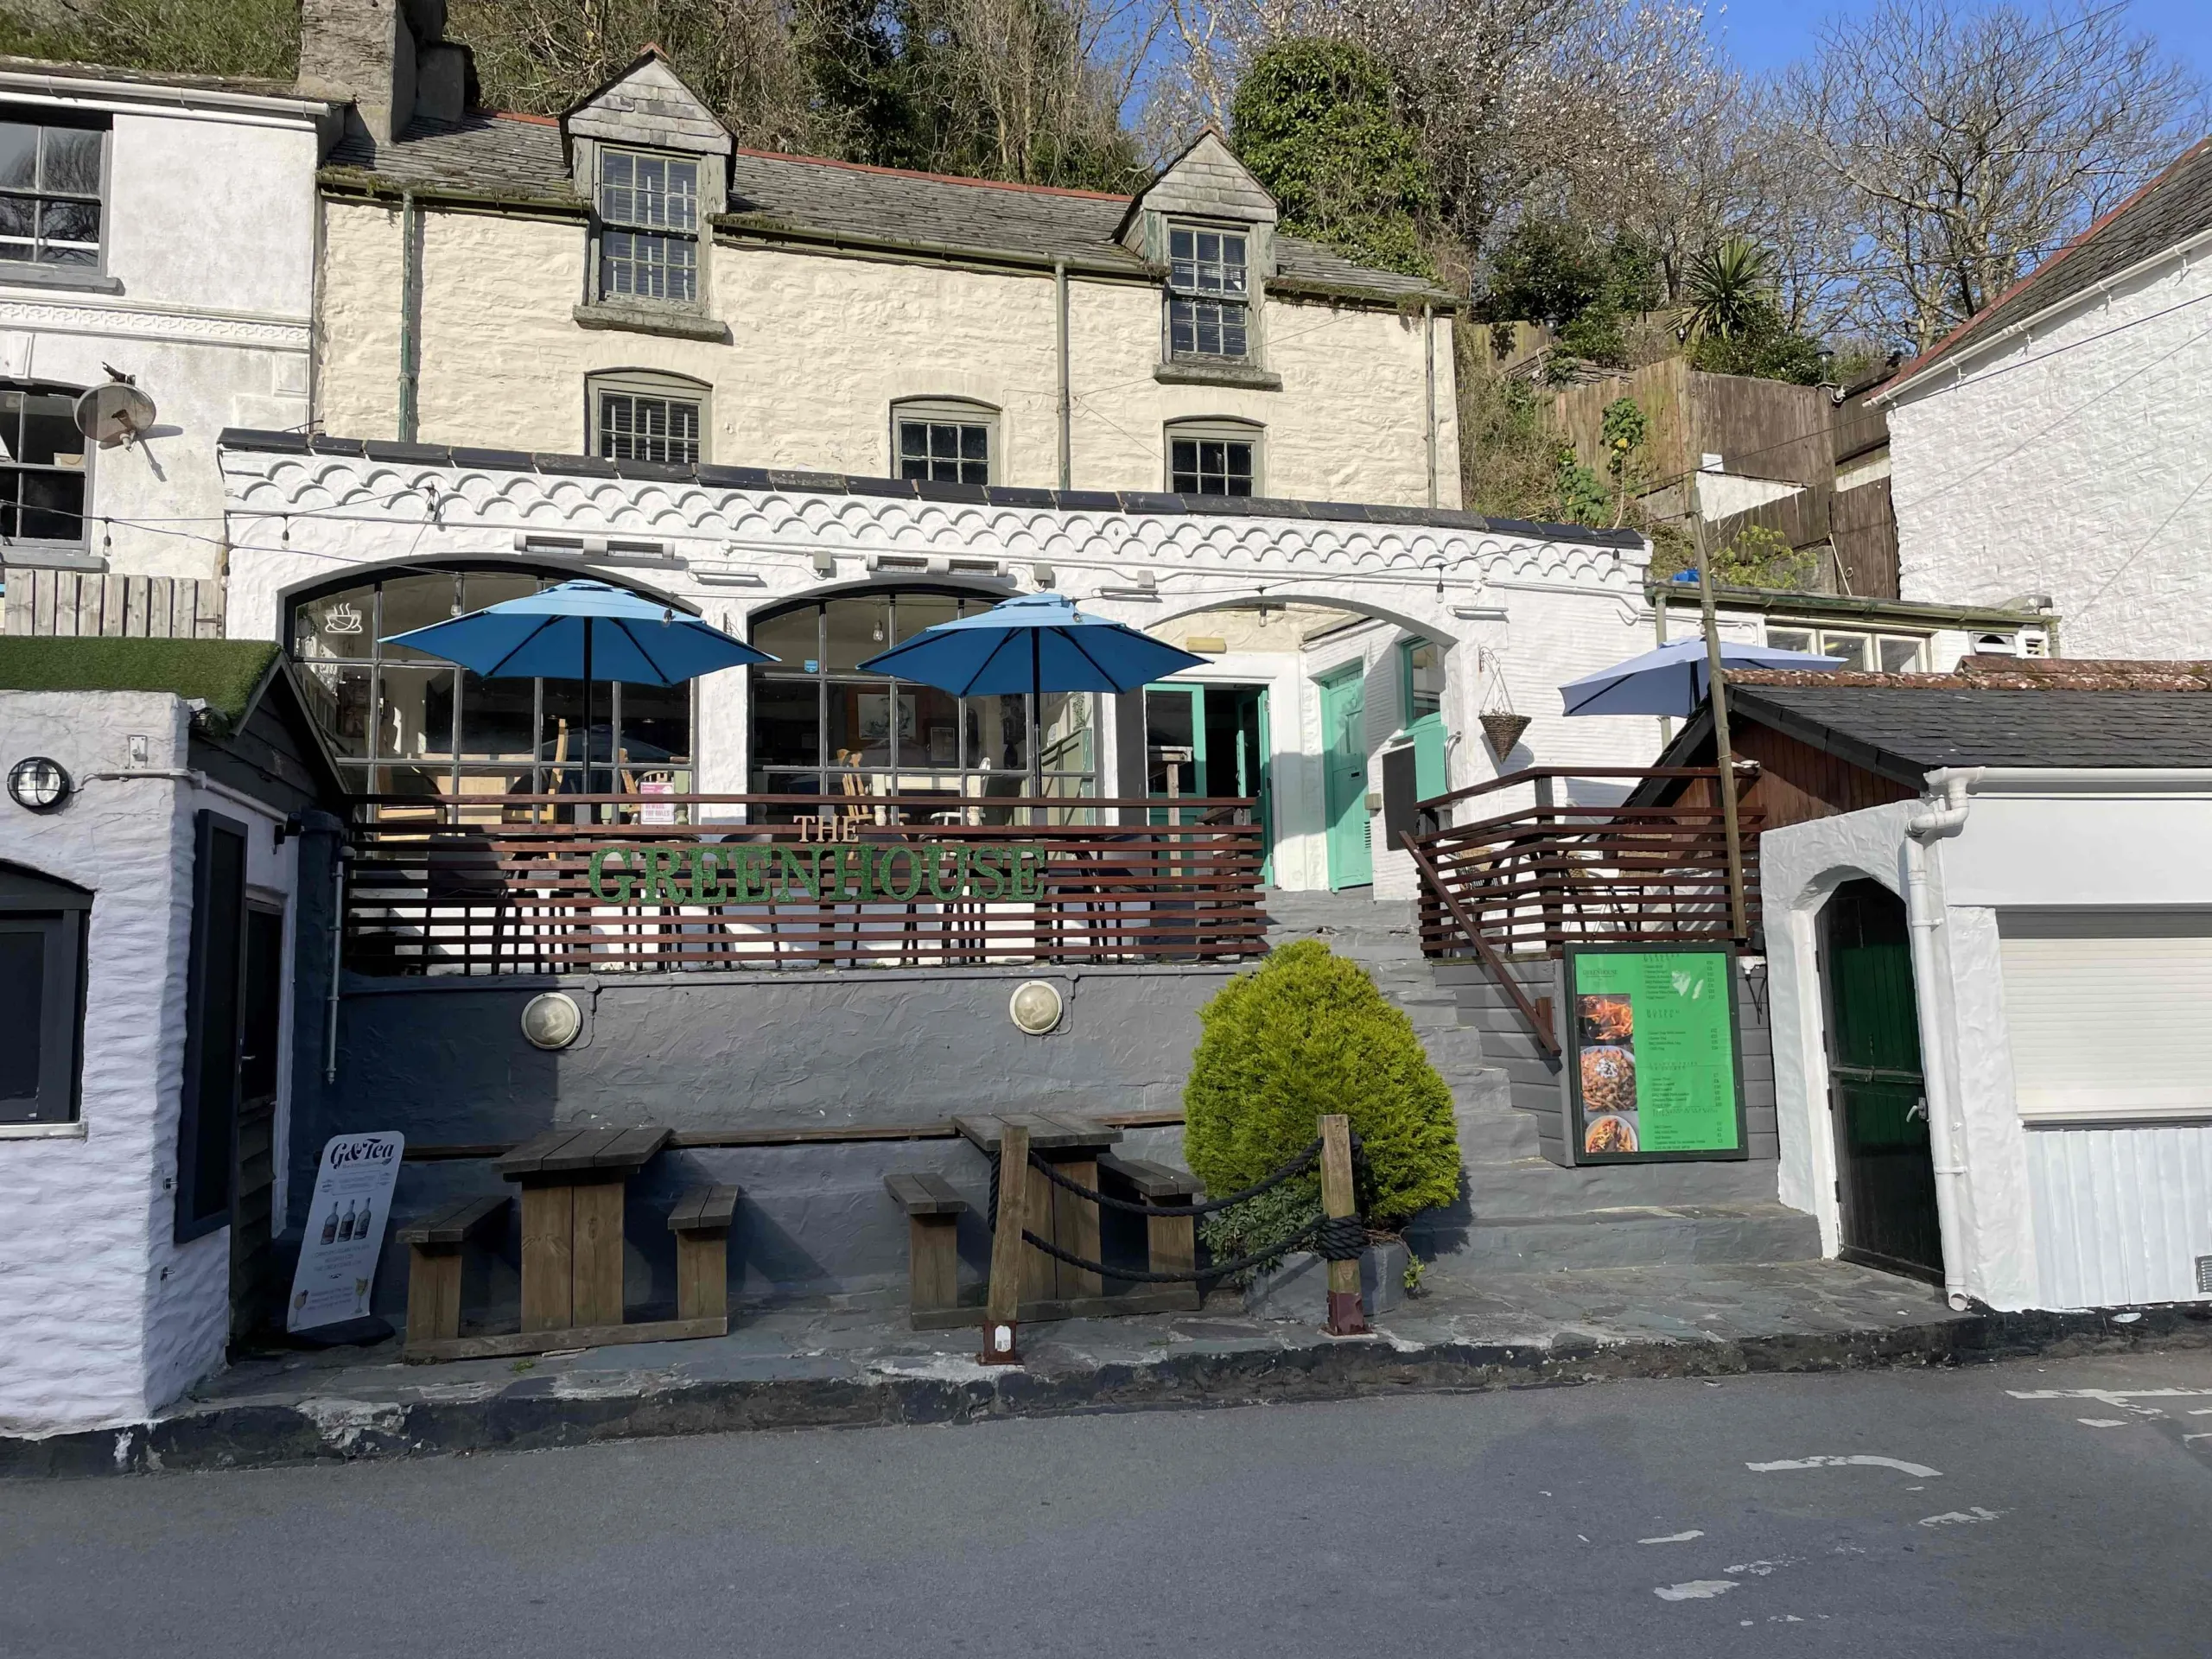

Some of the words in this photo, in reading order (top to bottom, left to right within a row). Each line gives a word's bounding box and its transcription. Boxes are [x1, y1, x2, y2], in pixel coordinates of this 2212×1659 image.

[793, 815, 861, 843] THE
[588, 844, 1046, 905] GREENHOUSE
[330, 1138, 395, 1170] G&Tea
